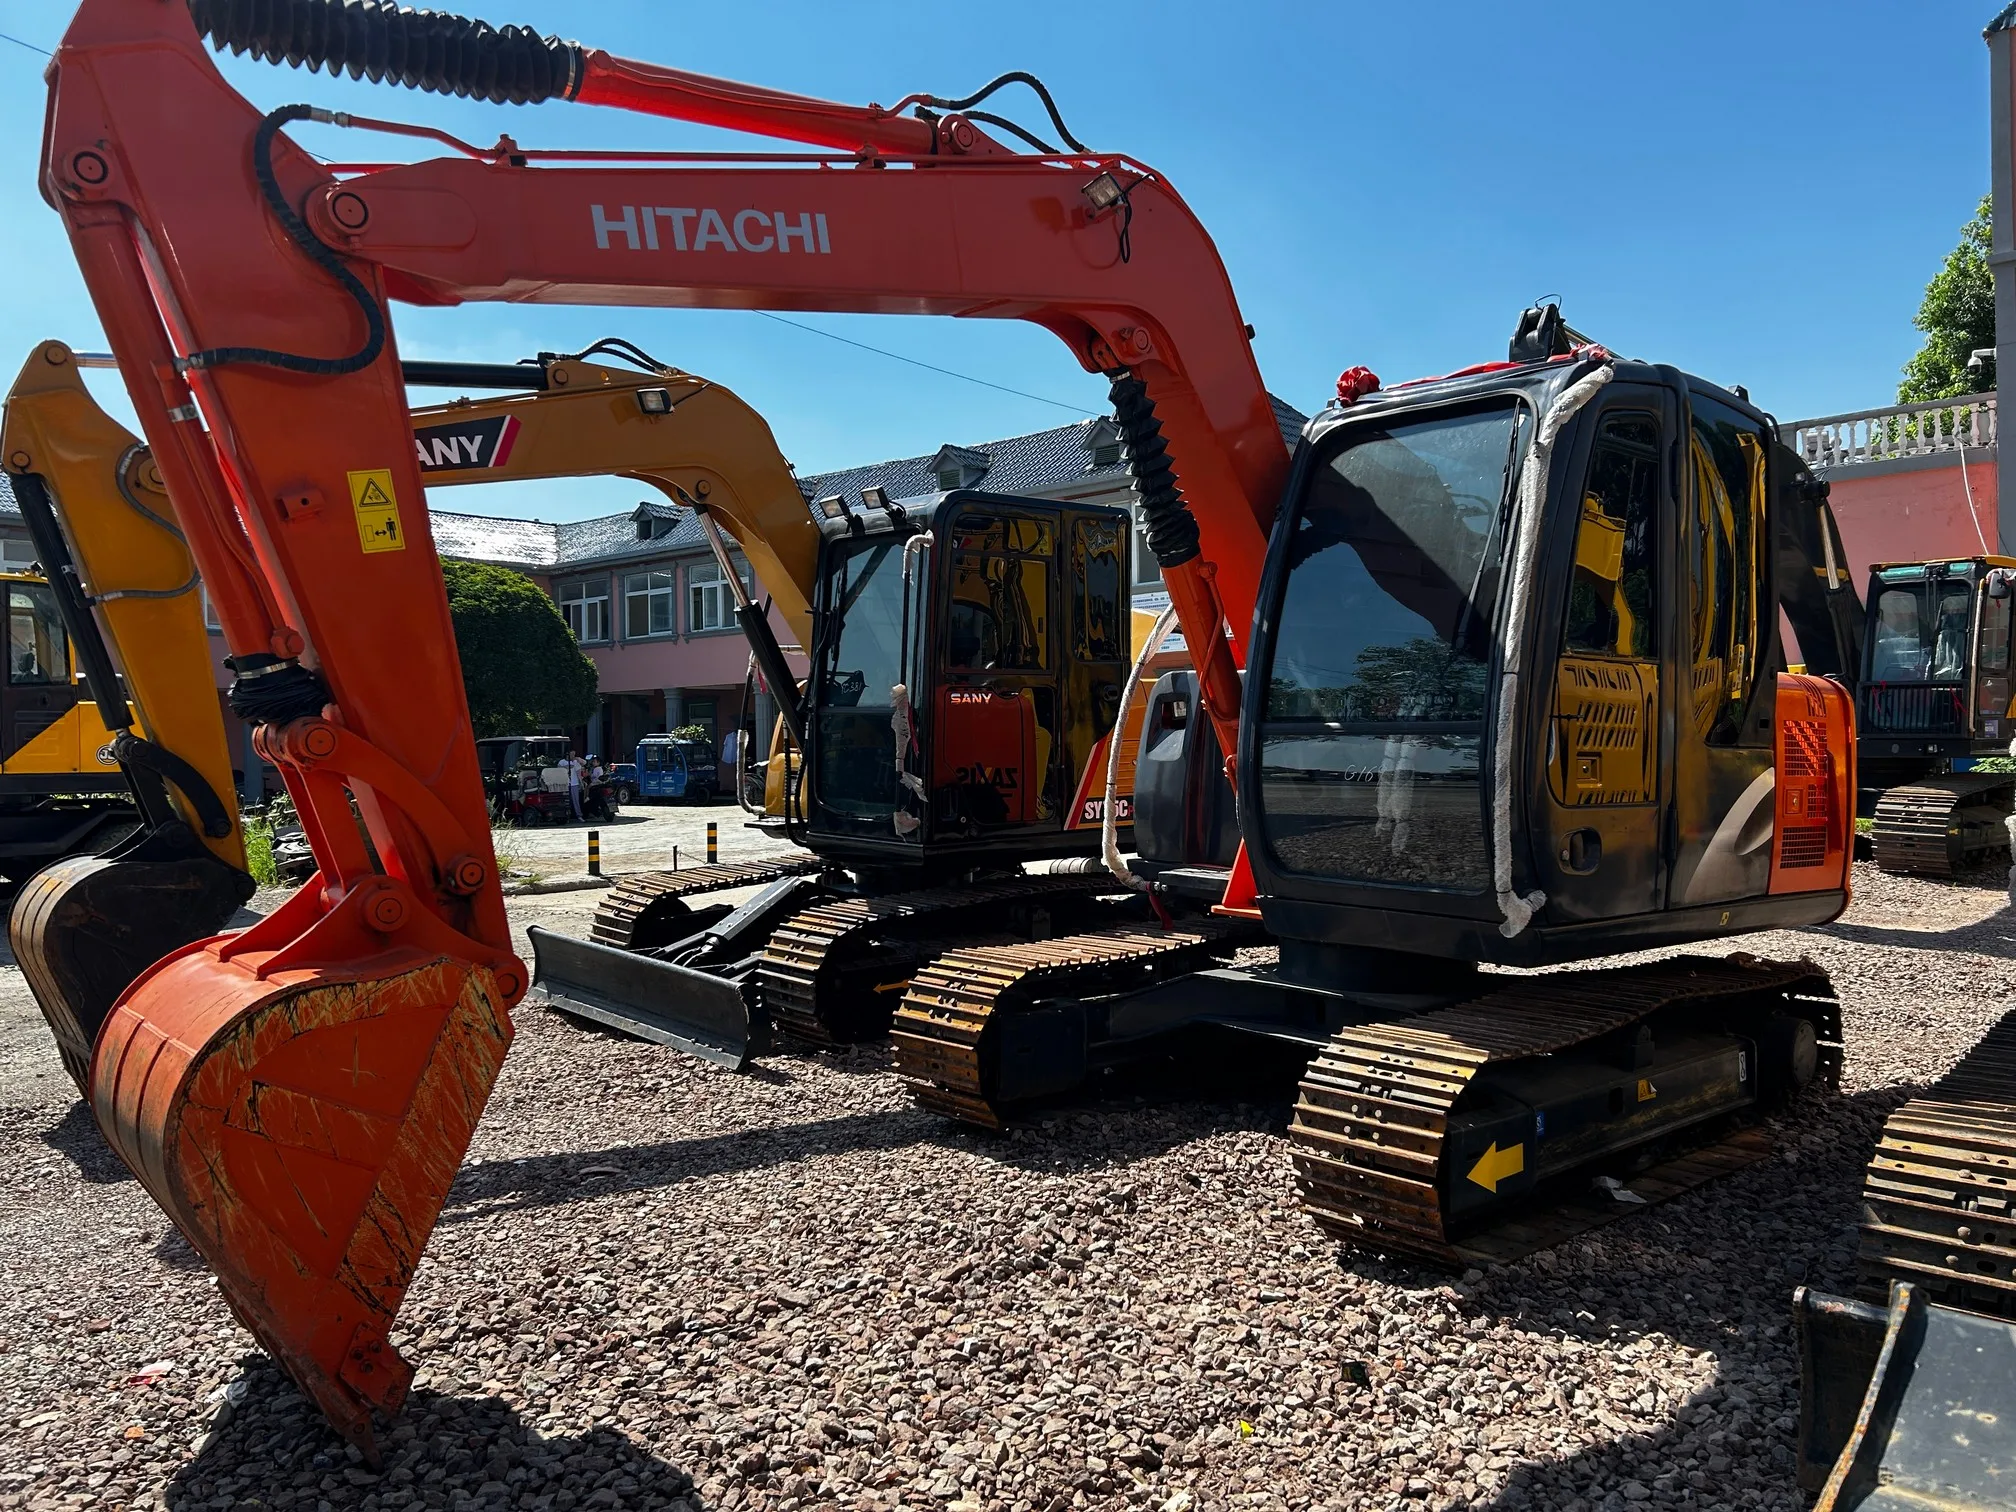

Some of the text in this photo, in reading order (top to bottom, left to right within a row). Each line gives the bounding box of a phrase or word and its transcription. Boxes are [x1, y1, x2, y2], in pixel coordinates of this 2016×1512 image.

[590, 204, 832, 254] HITACHI
[414, 434, 484, 466] ANY
[950, 692, 992, 705] SANY
